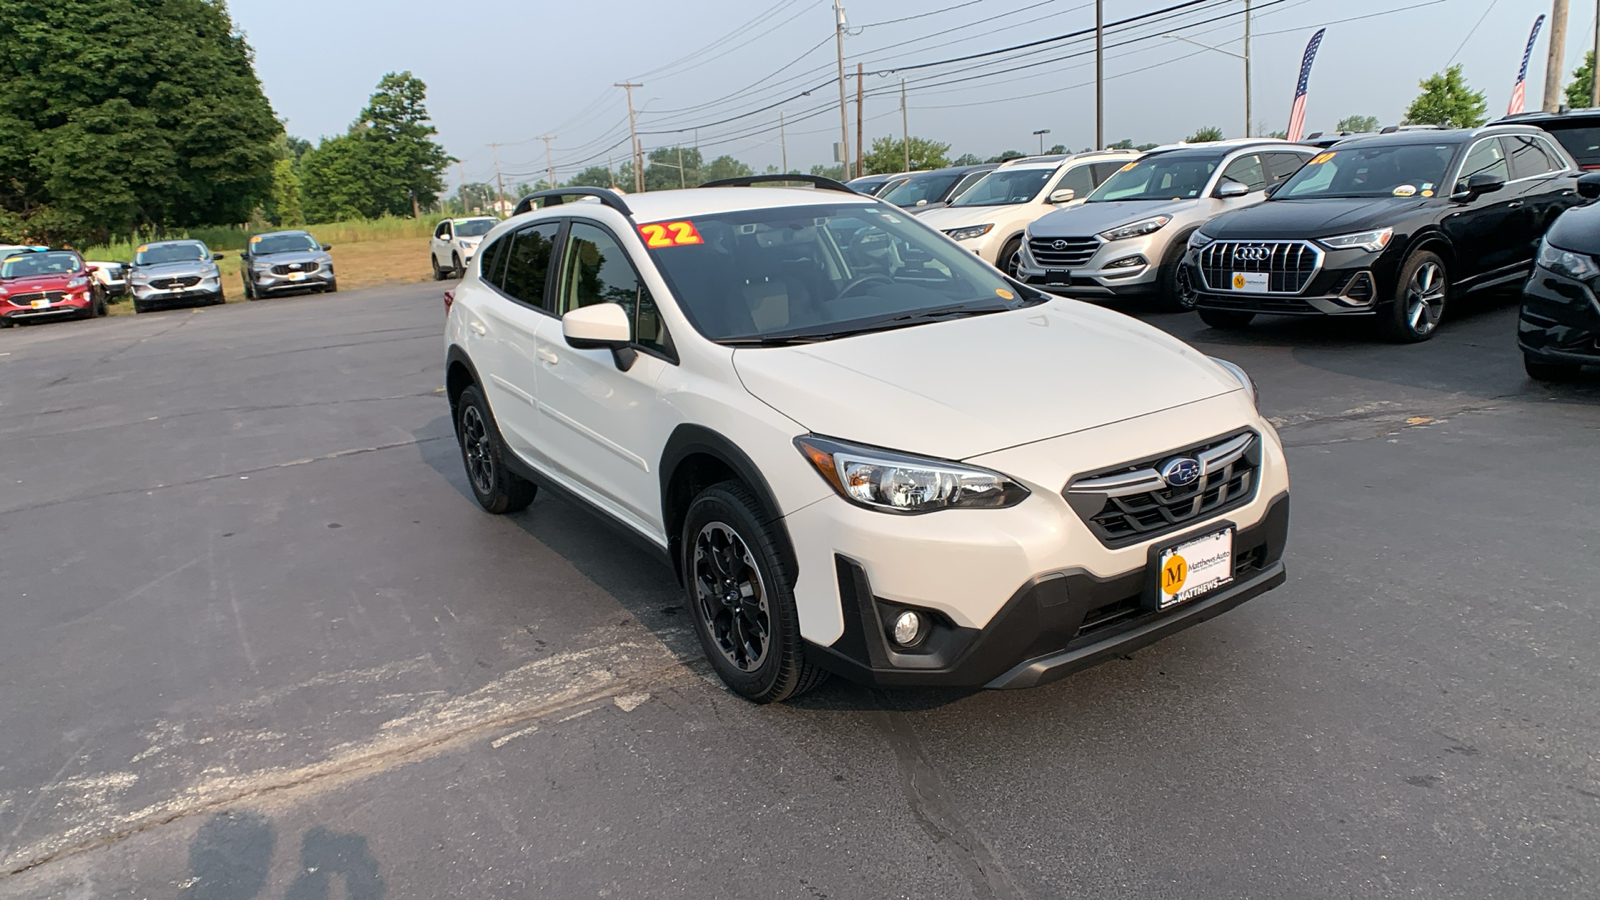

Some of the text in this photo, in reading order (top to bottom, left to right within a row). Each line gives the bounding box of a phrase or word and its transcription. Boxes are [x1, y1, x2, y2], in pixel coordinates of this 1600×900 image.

[641, 222, 700, 247] 22
[1188, 557, 1216, 572] Matthews
[1216, 551, 1230, 561] Auto
[1166, 563, 1183, 588] M
[1178, 579, 1218, 602] MATTHEWS
